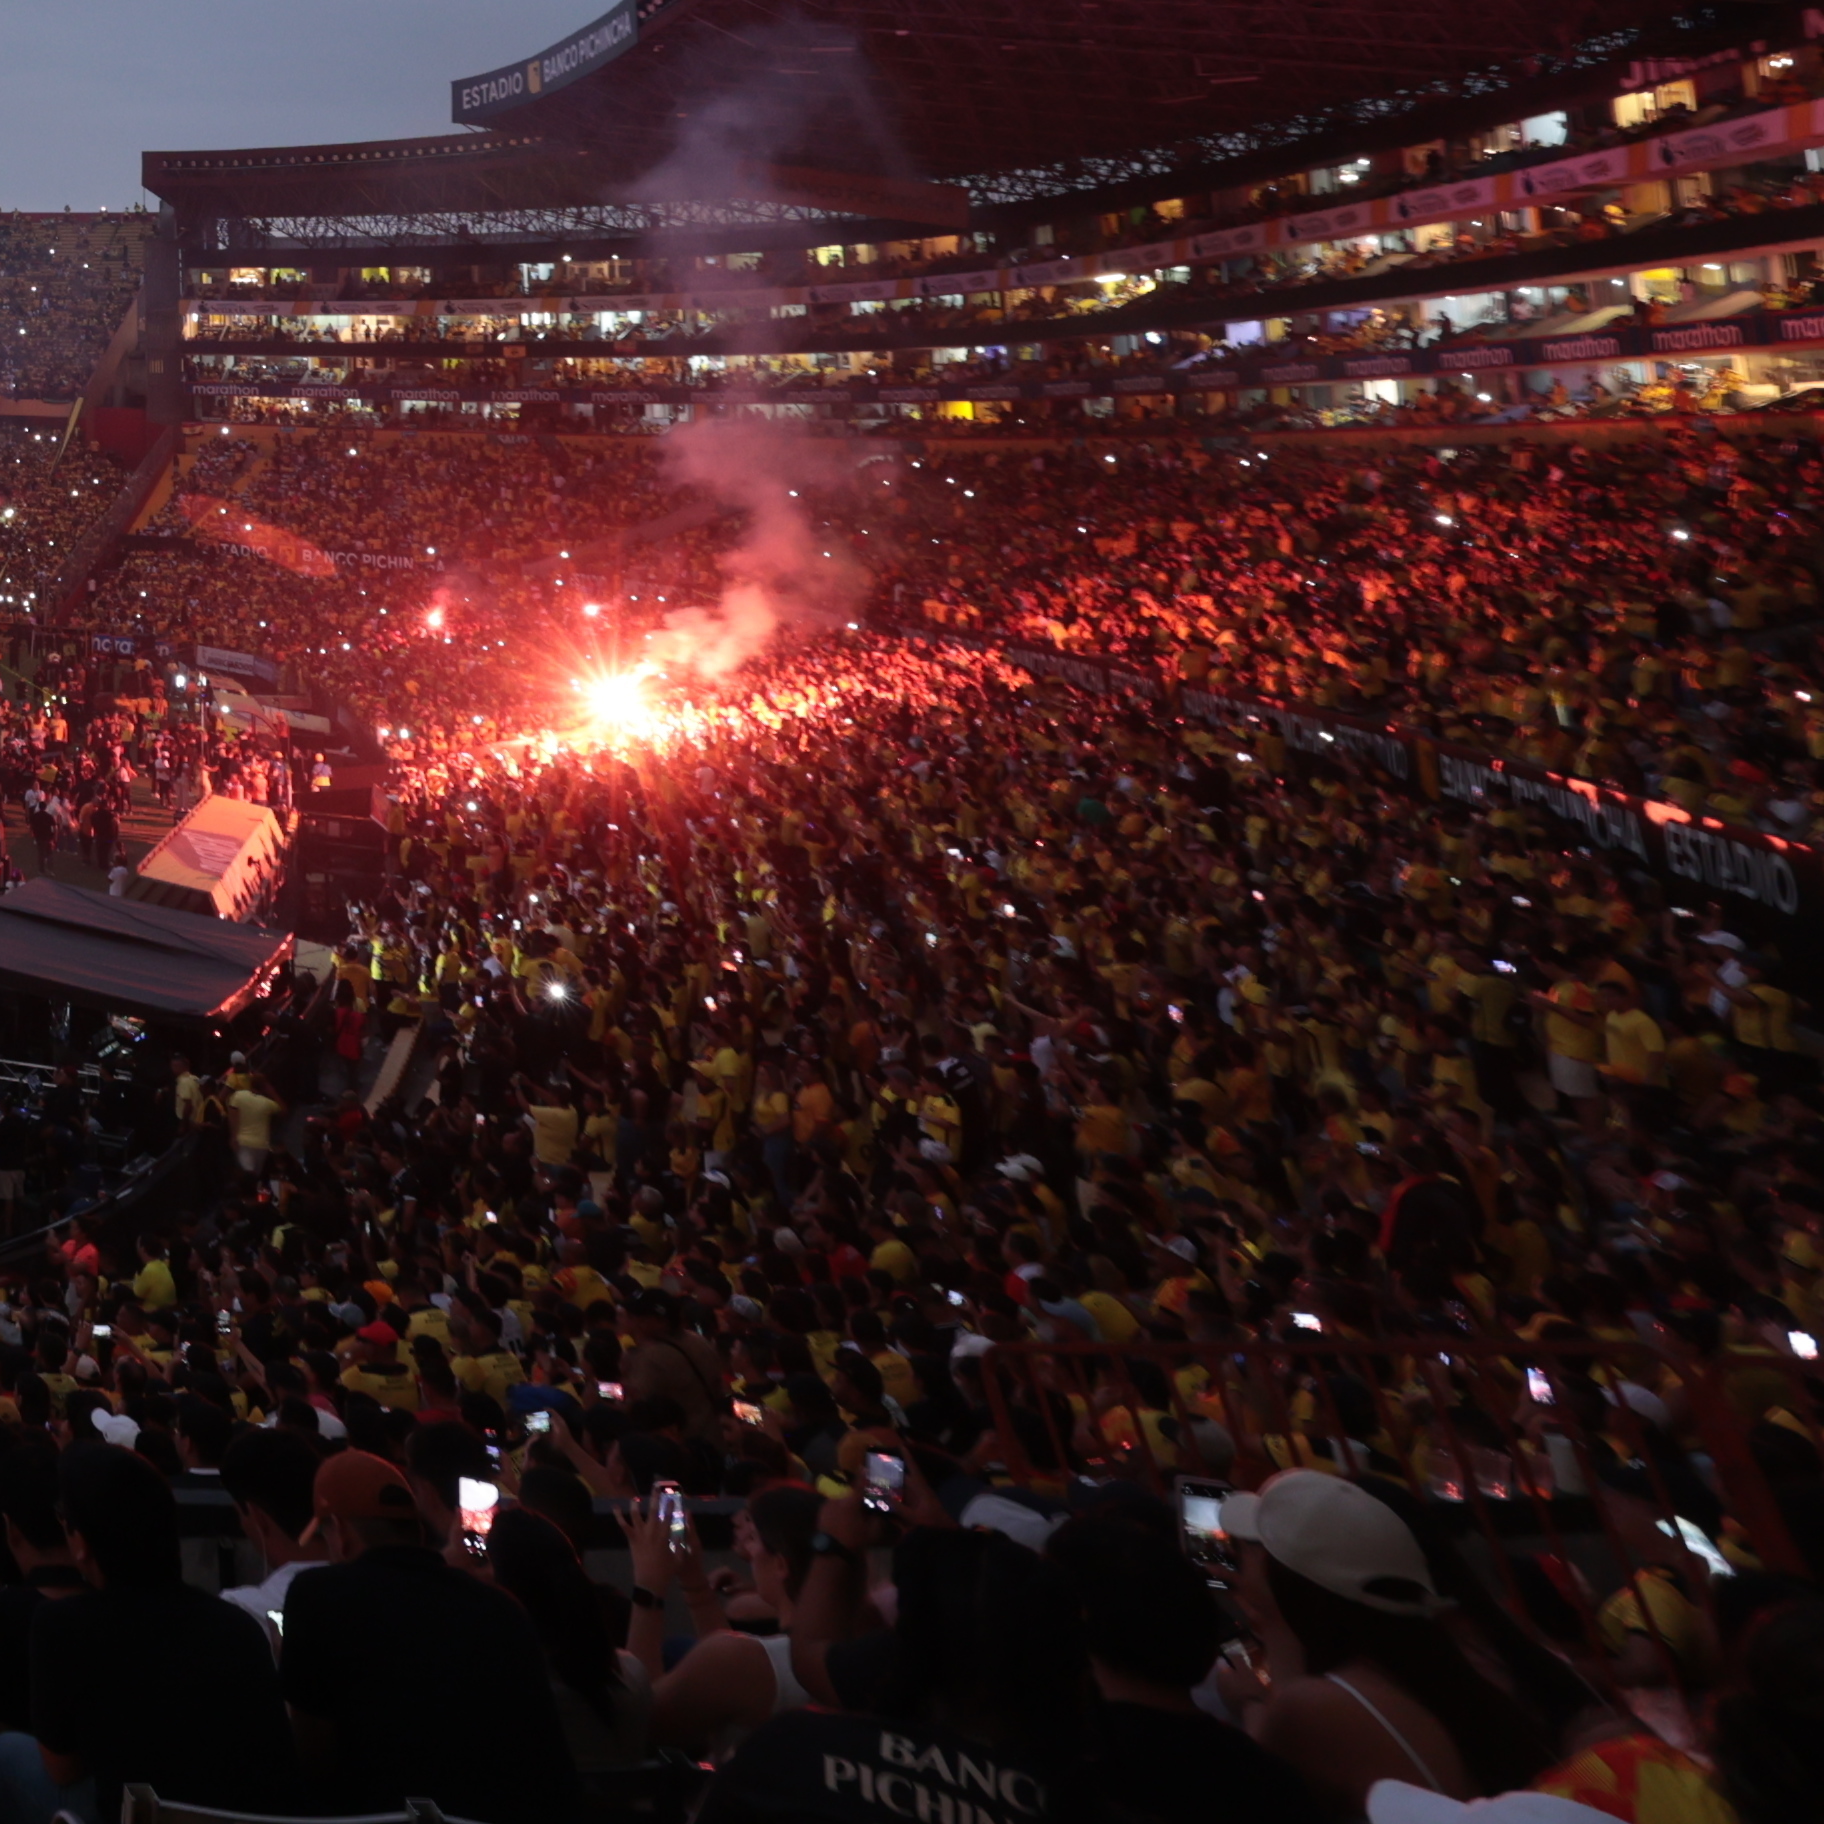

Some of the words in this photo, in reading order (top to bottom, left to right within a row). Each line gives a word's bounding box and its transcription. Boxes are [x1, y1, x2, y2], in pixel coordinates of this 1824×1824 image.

[461, 72, 523, 110] ESTADIO
[542, 45, 579, 83] BANCO
[578, 11, 632, 64] PICHINCHA
[193, 384, 259, 395] marathon
[292, 386, 359, 398] marathon
[391, 388, 459, 400] marathon
[220, 542, 268, 559] TADIO
[1664, 818, 1799, 916] ESTADIO
[822, 1753, 1016, 1824] PICHI
[879, 1729, 1048, 1818] BANC
